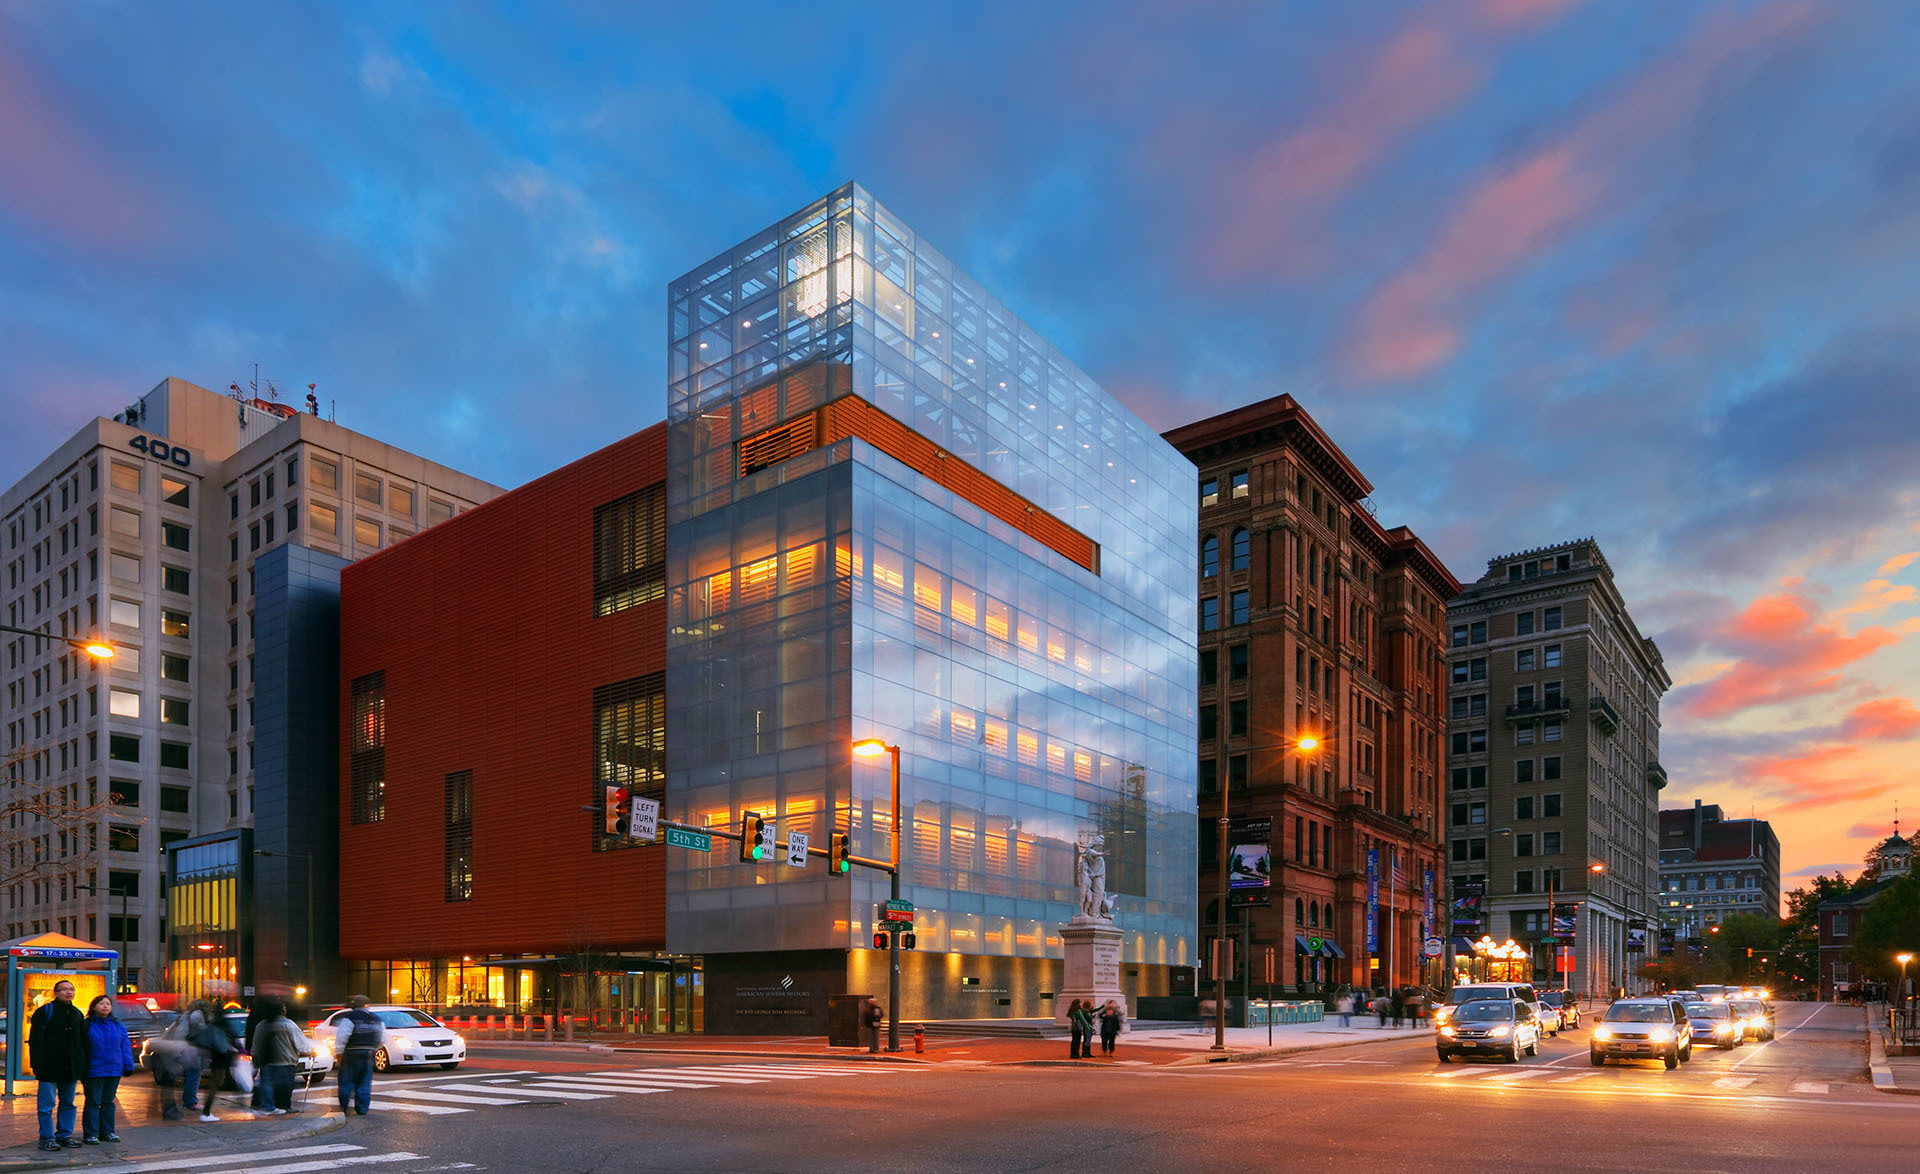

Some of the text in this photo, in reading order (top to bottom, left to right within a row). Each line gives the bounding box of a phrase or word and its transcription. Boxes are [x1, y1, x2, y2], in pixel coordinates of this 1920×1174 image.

[129, 434, 191, 467] 400
[636, 802, 655, 813] LEFT
[636, 813, 655, 824] TURN
[632, 823, 655, 835] SIGNAL
[762, 828, 773, 836] EFT
[673, 832, 705, 848] 5th St
[792, 834, 805, 845] ONE
[791, 844, 805, 854] WAY
